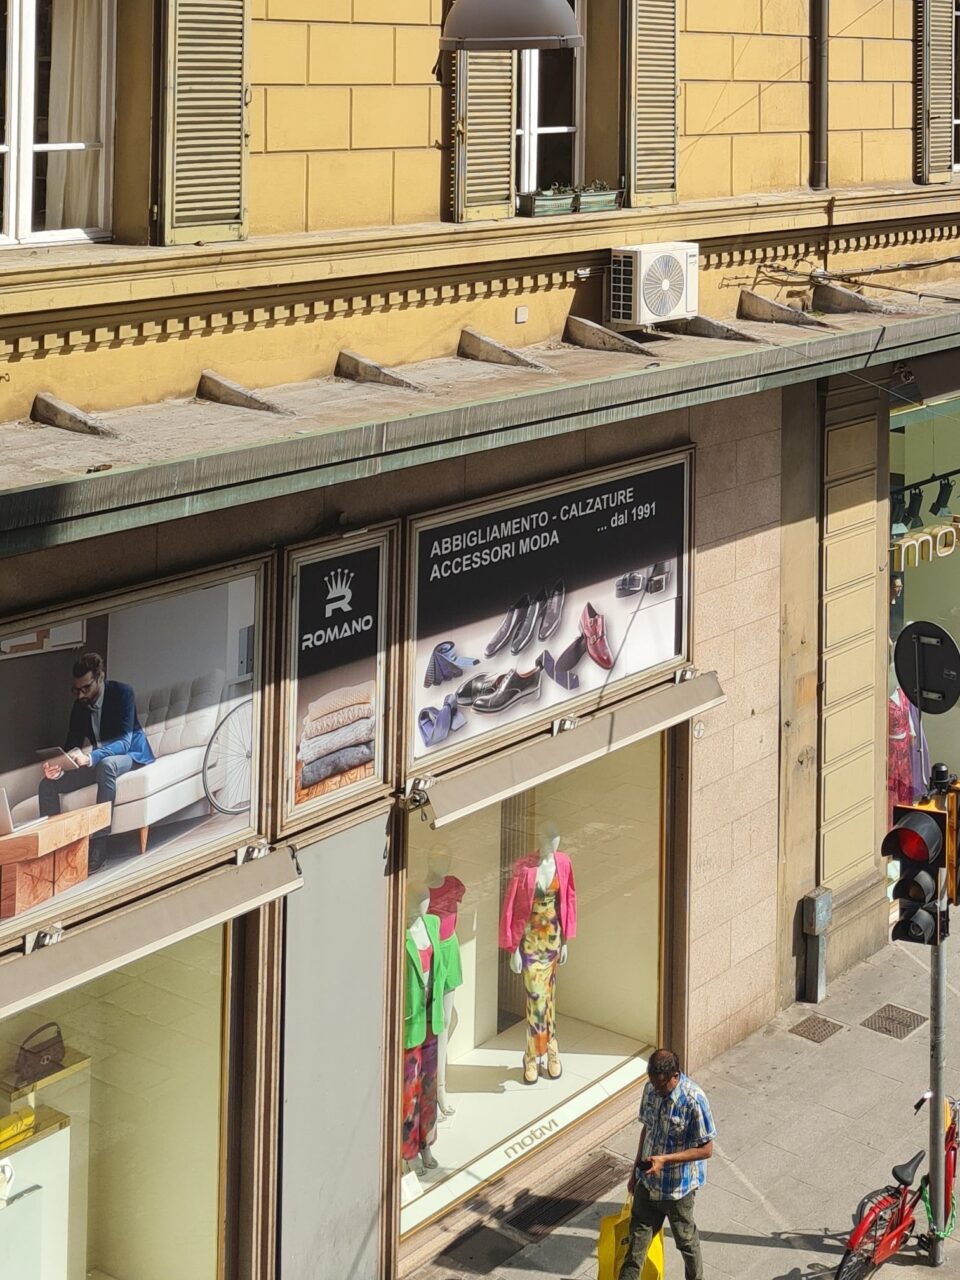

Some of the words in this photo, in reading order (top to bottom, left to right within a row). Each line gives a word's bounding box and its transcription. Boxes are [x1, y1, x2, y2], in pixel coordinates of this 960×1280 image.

[430, 511, 549, 558] ABBIGLIAMENTO
[560, 487, 635, 521] CALZATURE
[610, 510, 628, 529] dal
[631, 501, 657, 522] 1991
[429, 541, 516, 582] ACCESSORI
[519, 530, 560, 556] MODA
[302, 615, 373, 651] ROMANO
[504, 1118, 559, 1159] motivi
